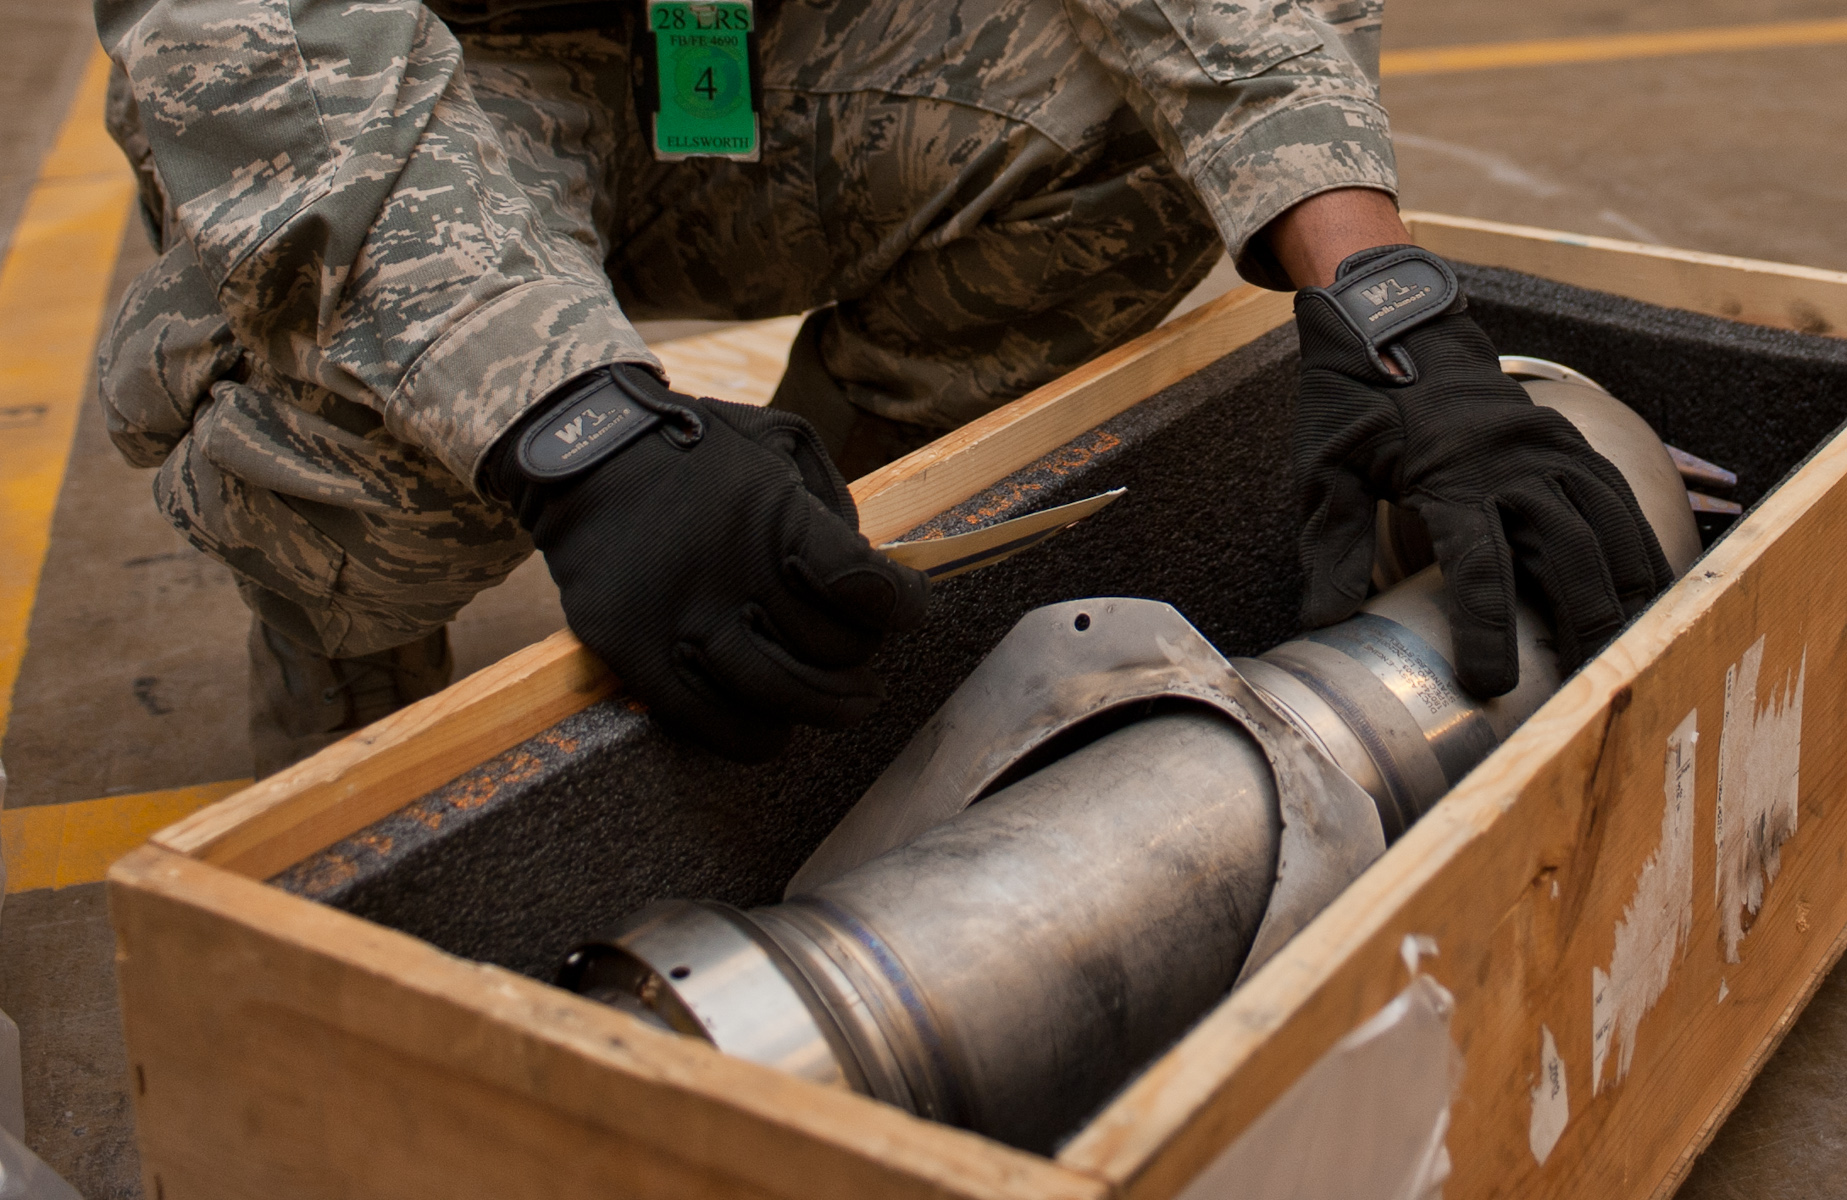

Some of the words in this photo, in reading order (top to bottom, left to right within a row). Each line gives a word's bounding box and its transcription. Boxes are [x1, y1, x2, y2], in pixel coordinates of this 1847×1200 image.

[657, 8, 687, 30] 28
[695, 8, 750, 31] LRS
[711, 35, 739, 47] 4690
[693, 66, 718, 101] 4
[667, 135, 750, 149] ELLSWORTH
[1417, 691, 1438, 714] DUCT
[1429, 683, 1450, 708] SPEC
